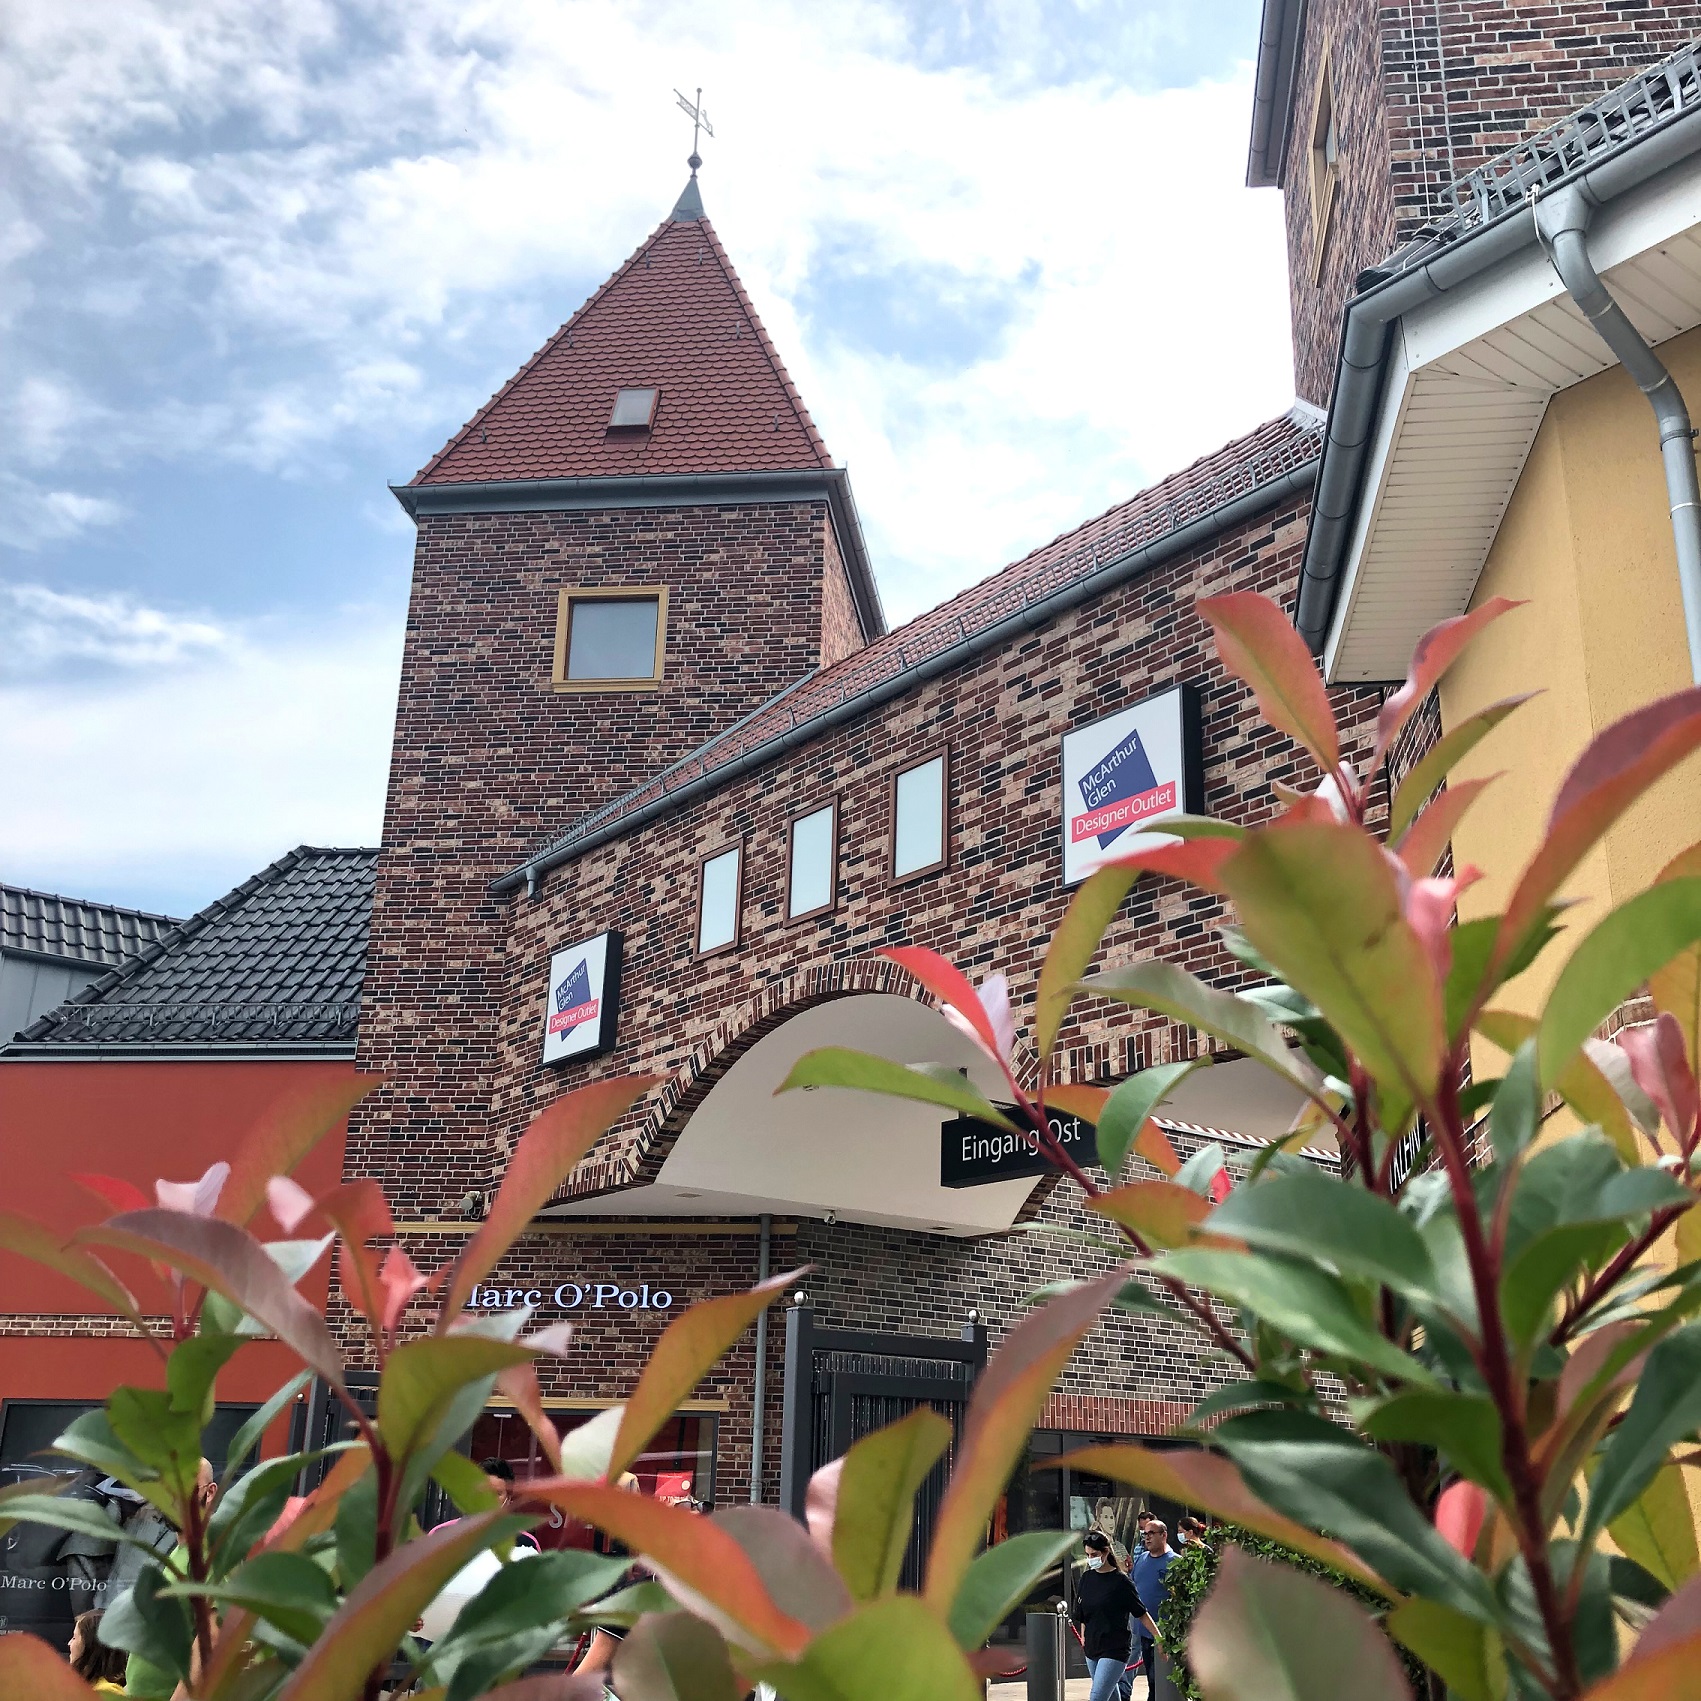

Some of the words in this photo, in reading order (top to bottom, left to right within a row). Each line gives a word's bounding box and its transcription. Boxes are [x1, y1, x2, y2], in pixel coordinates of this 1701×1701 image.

[1082, 737, 1138, 795] McArthur
[1088, 778, 1117, 808] Glen
[1076, 805, 1130, 835] Designer
[1131, 788, 1172, 815] Outlet
[557, 964, 586, 1000] McArthur
[551, 1010, 578, 1029] Designer
[577, 1003, 597, 1020] Outlet
[558, 991, 574, 1011] Glen
[962, 1128, 1040, 1163] Eingang
[554, 1283, 673, 1309] O'Polo
[0, 1575, 46, 1590] Marc
[51, 1576, 107, 1592] O'Polo
